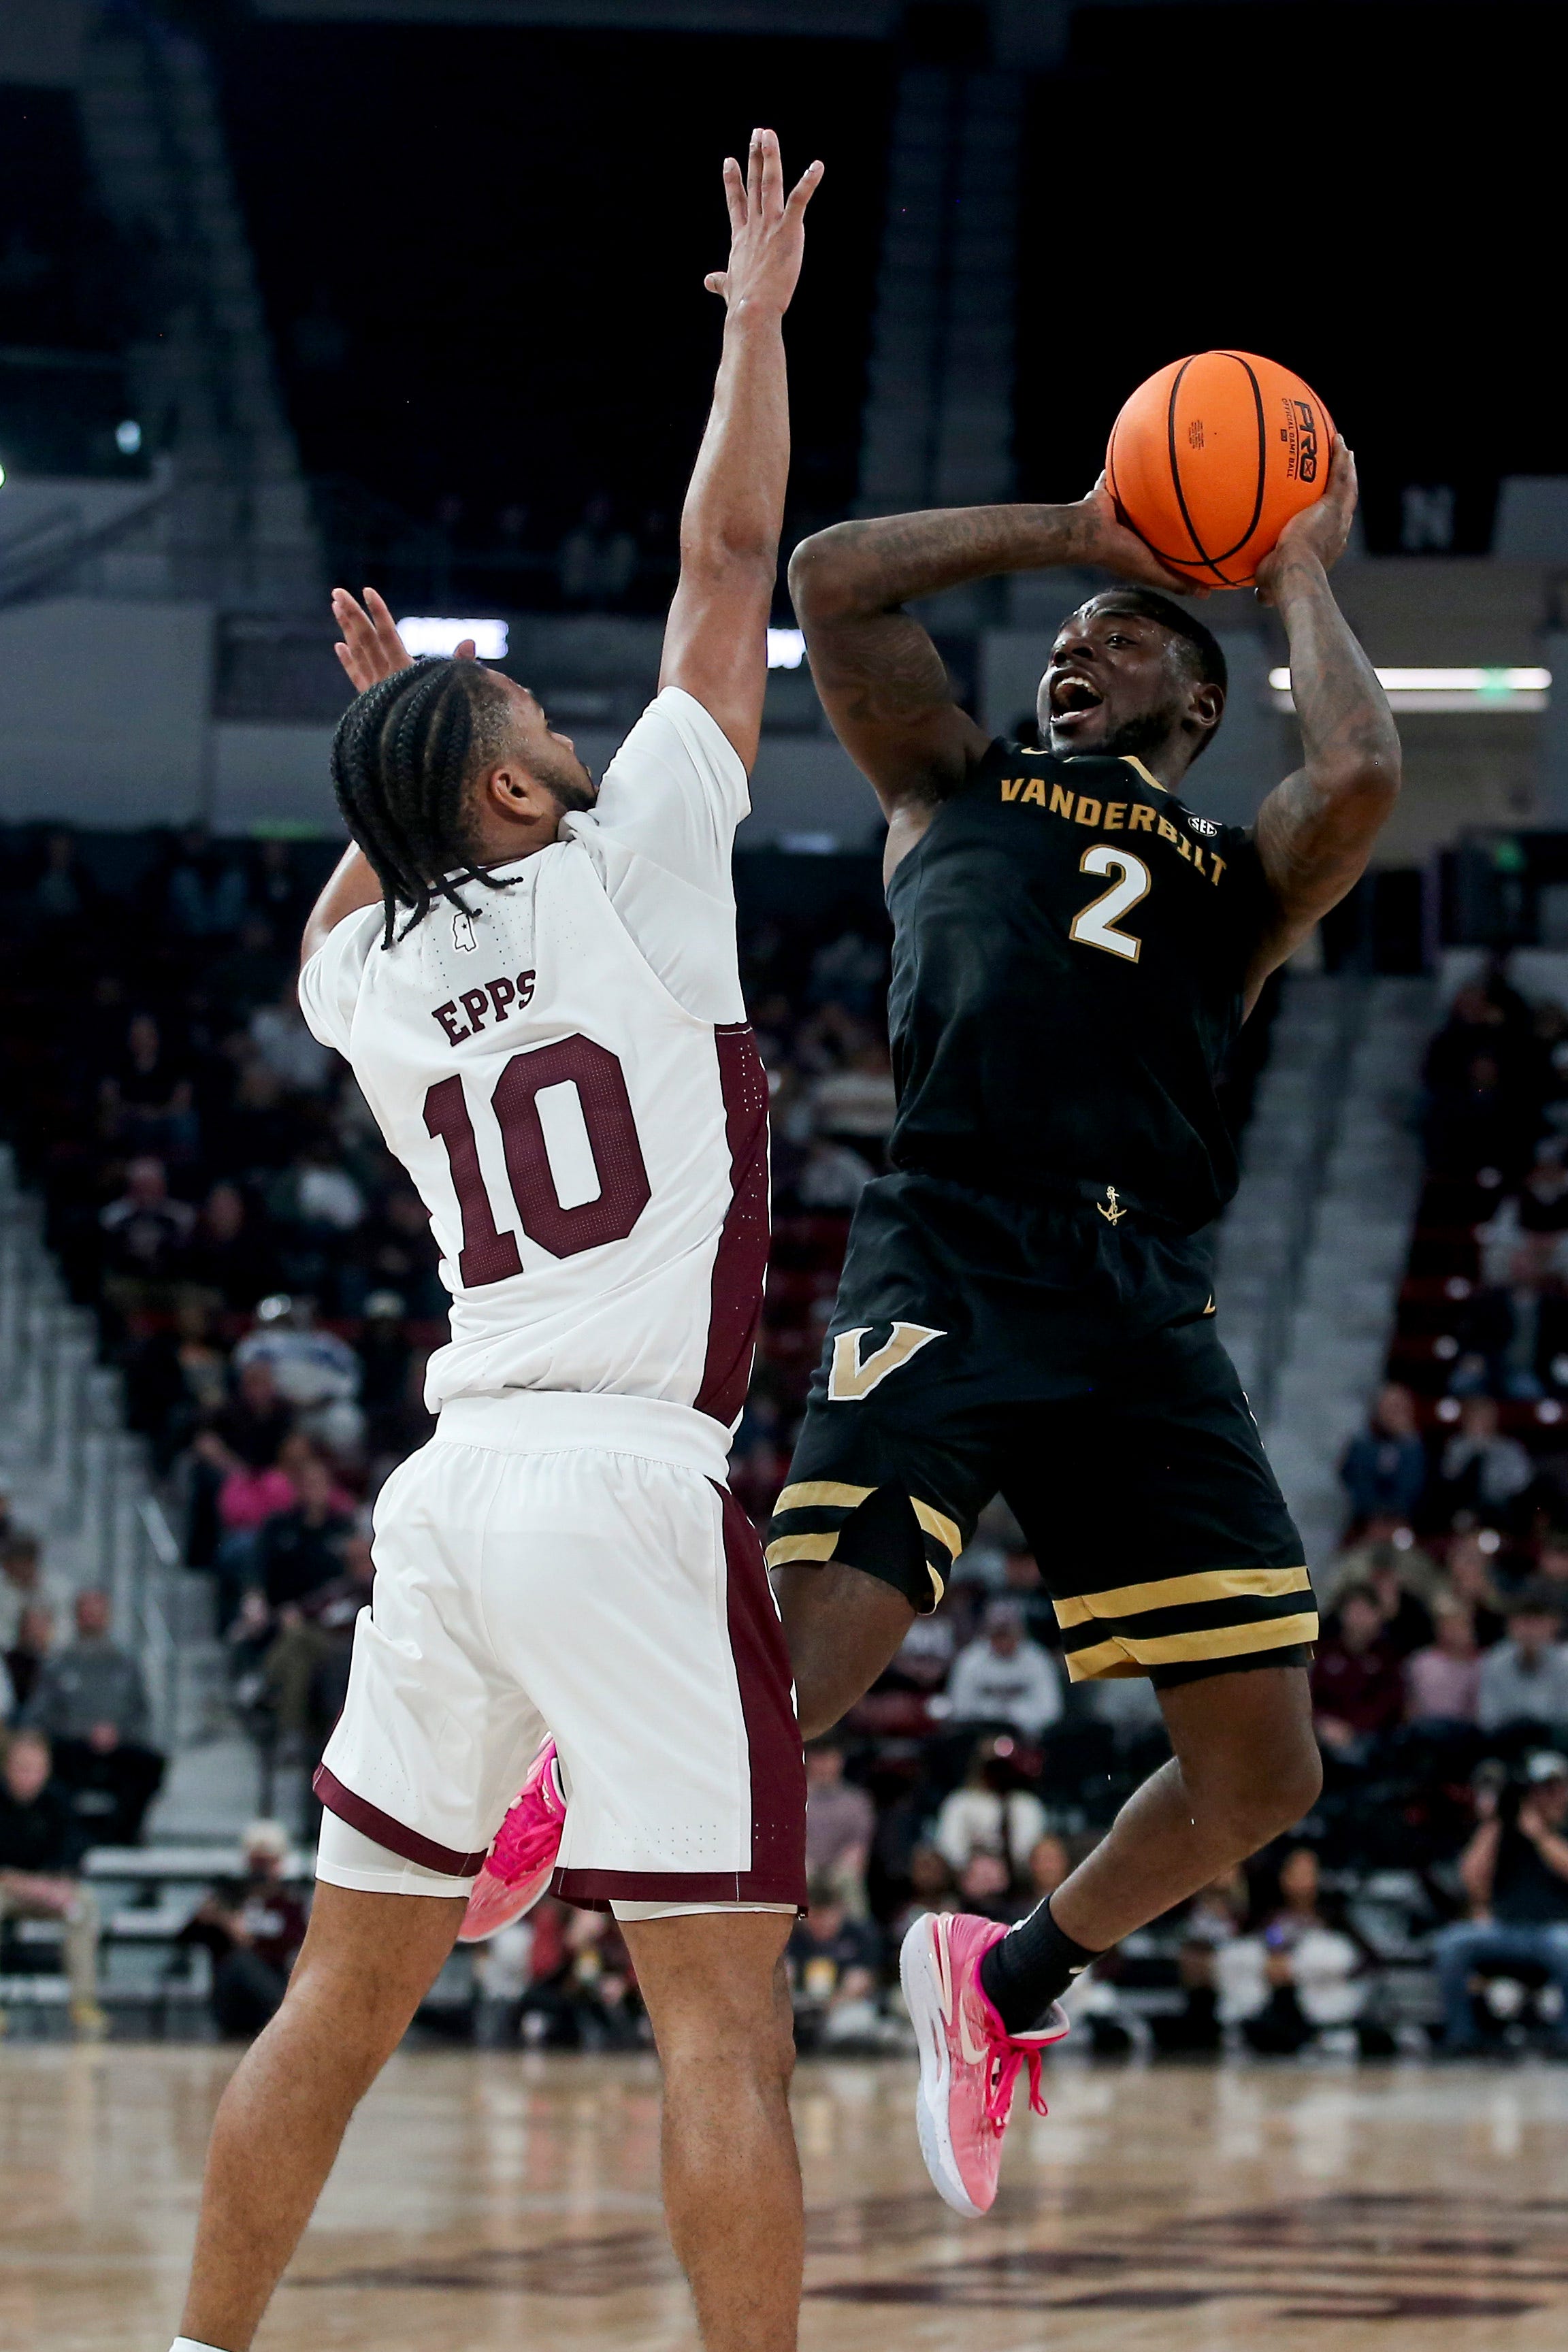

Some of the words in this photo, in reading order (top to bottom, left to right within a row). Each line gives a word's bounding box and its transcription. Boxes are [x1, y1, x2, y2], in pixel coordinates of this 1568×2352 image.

[1281, 397, 1294, 429] OFFICIAL
[1294, 400, 1318, 483] PRO
[1286, 457, 1295, 478] BALL
[1000, 778, 1226, 886] VANDERBILT
[1191, 817, 1215, 835] SEC
[1069, 843, 1152, 964] 2
[431, 969, 536, 1047] EPPS
[423, 1032, 652, 1288] 10
[828, 1322, 947, 1401] V
